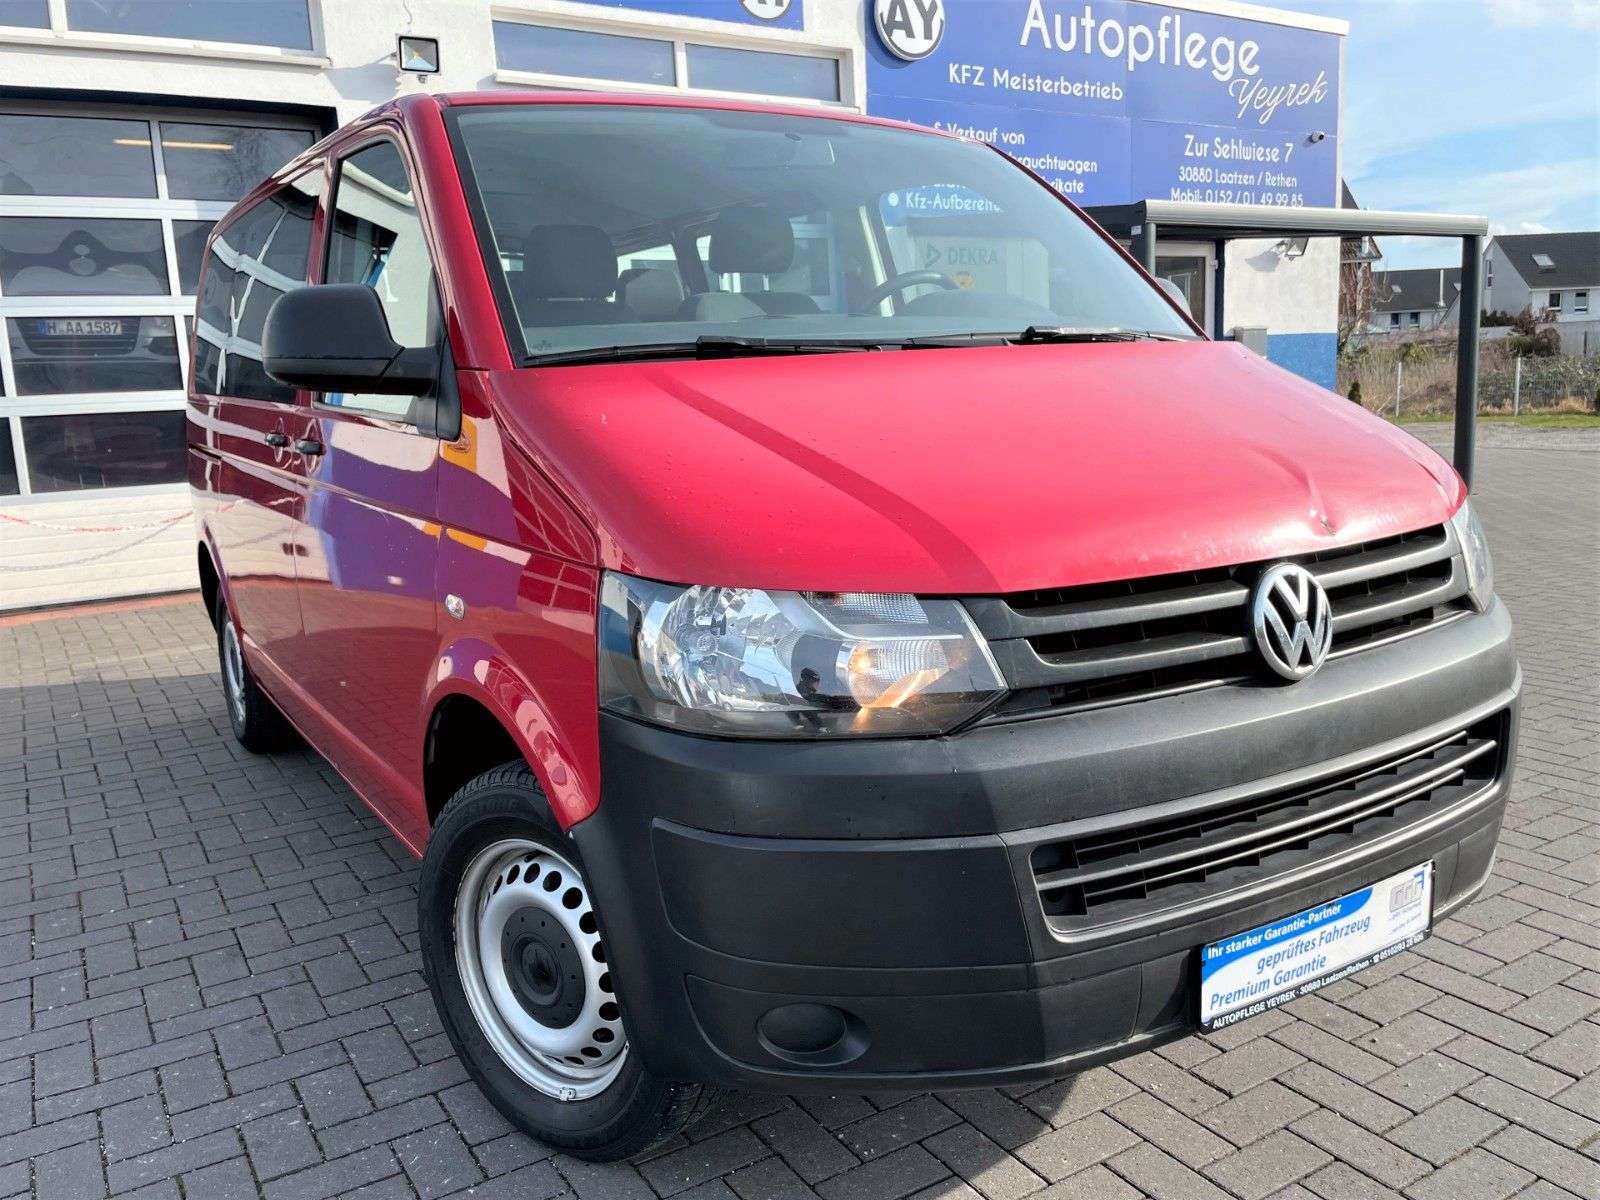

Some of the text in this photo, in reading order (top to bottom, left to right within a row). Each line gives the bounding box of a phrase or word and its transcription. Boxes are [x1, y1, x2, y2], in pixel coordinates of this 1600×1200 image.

[881, 0, 938, 40] AY
[1019, 0, 1261, 82] Autopflege
[949, 63, 1124, 101] KFZ Meisterbetrieb
[1228, 70, 1328, 125] Yeyrek
[1002, 131, 1025, 145] von
[1184, 134, 1294, 163] Zur Sehlwiese 7
[1170, 187, 1203, 202] Mobil:
[1206, 189, 1233, 204] 0152
[1178, 166, 1213, 183] 30880
[1215, 169, 1255, 186] Laatzen
[1265, 173, 1298, 188] Rethen
[947, 248, 1000, 265] DEKRA
[87, 319, 120, 335] 1587
[1208, 903, 1342, 960] Ihr starker Garantie-Partner
[1256, 938, 1317, 974] geprüftes
[1318, 916, 1371, 947] Fahrzeug
[1210, 954, 1327, 1010] Premium Garantie
[1212, 1002, 1266, 1030] AUTOPFLEGE
[1266, 989, 1296, 1009] YEYREK
